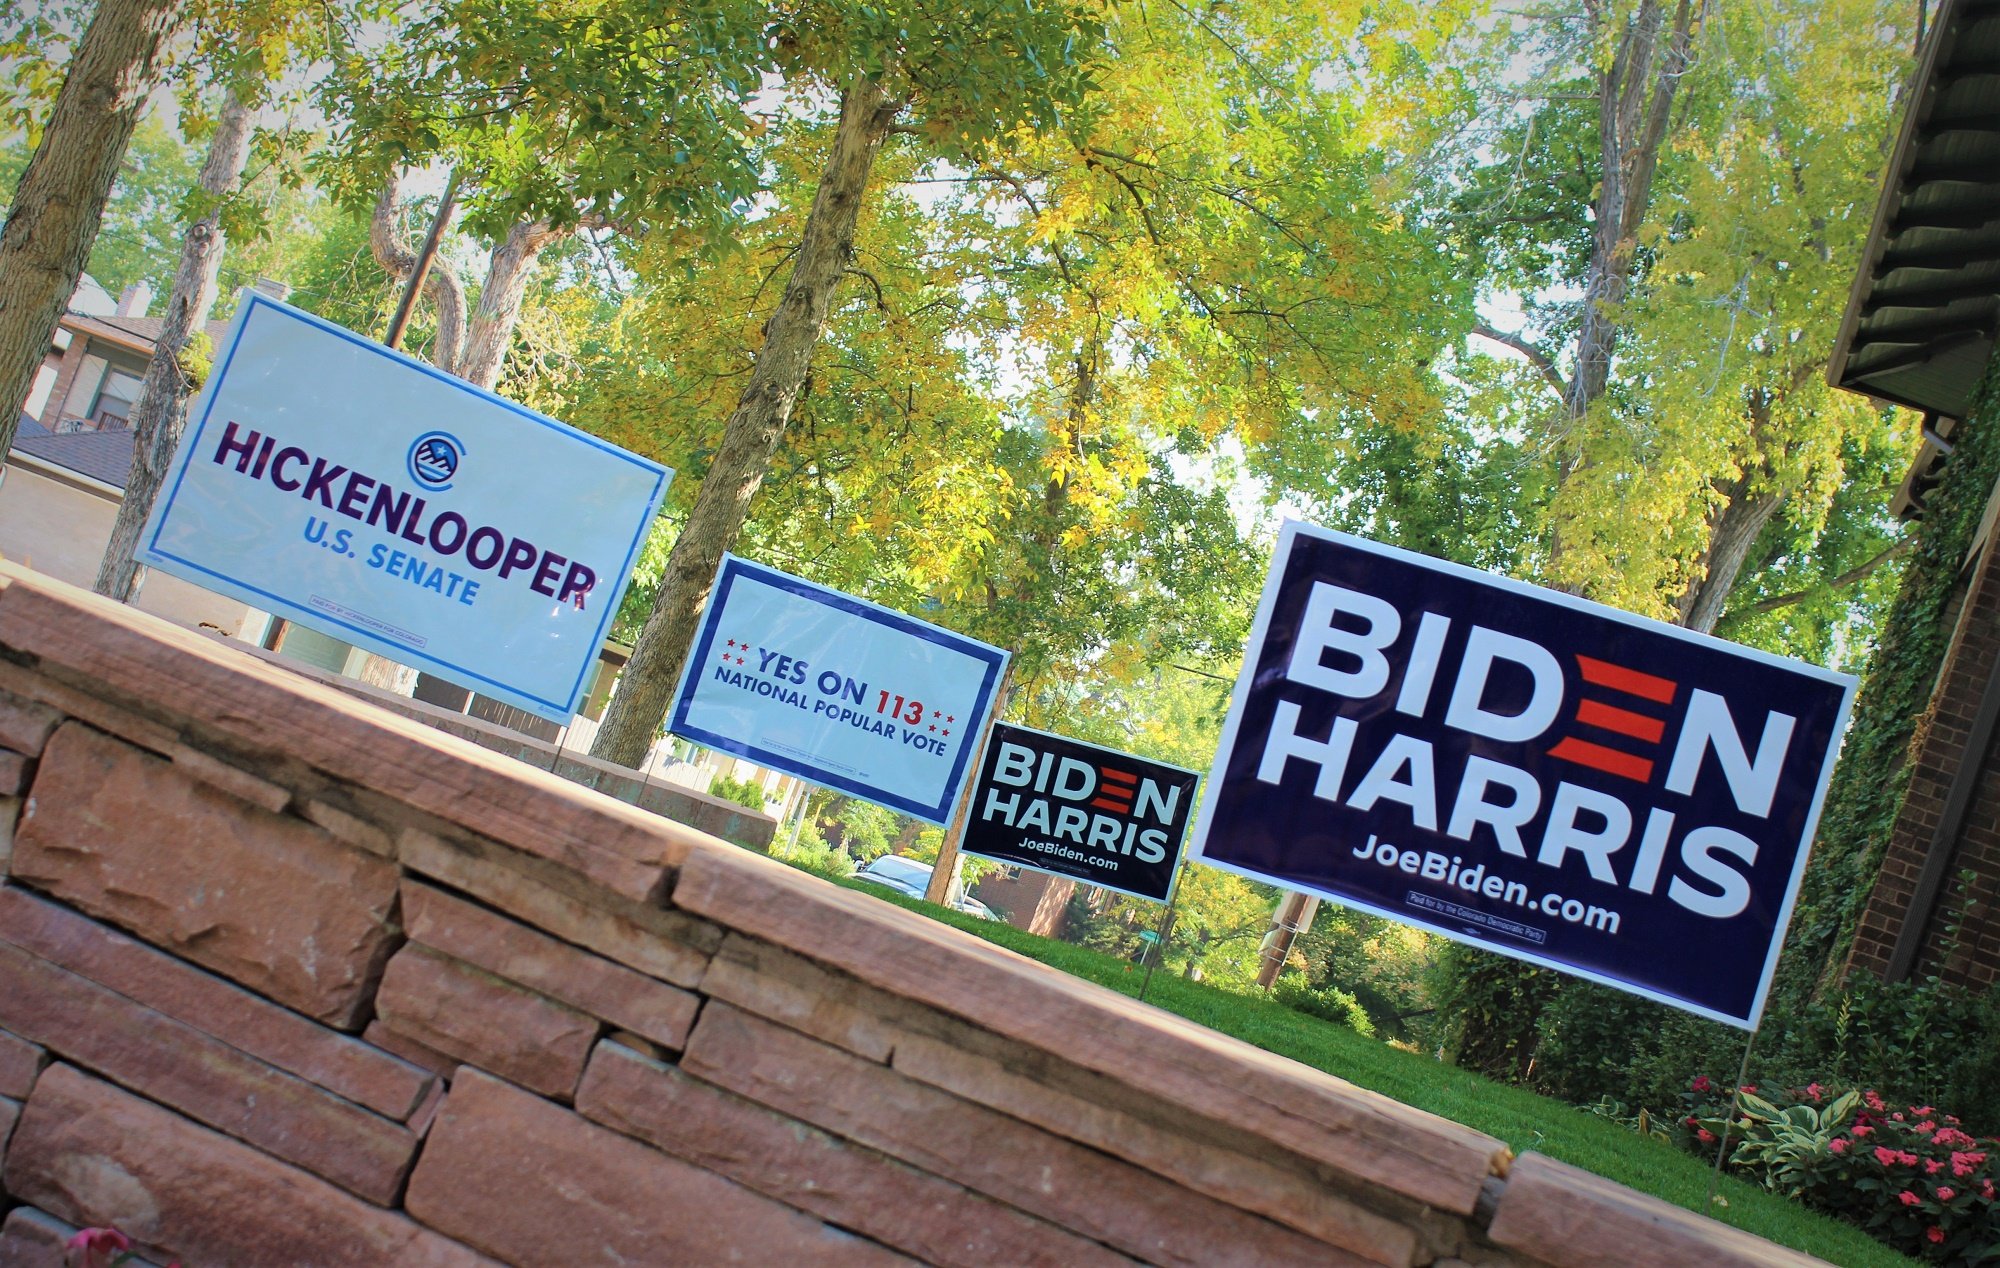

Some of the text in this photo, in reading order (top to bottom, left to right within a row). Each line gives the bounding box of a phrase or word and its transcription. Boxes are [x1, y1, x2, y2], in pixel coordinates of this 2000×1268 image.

[212, 421, 597, 610] HICKENLOOPER
[304, 516, 480, 606] U.S. SENATE
[714, 666, 808, 710] NATIONAL
[813, 699, 896, 740] POPULAR
[902, 729, 947, 757] VOTE
[758, 647, 924, 726] YES ON 113
[1285, 580, 1797, 819] BIDEN
[982, 788, 1169, 864] HARRIS
[992, 741, 1181, 826] BIDEN
[1256, 698, 1761, 919] HARRIS
[1018, 837, 1119, 871] JoeBiden.com
[1352, 834, 1621, 935] JoeBiden.com
[1410, 893, 1425, 905] Paid
[1445, 903, 1456, 914] the
[1457, 907, 1487, 923] Colorado
[1487, 917, 1524, 934] Democratic
[1524, 927, 1542, 941] Party
